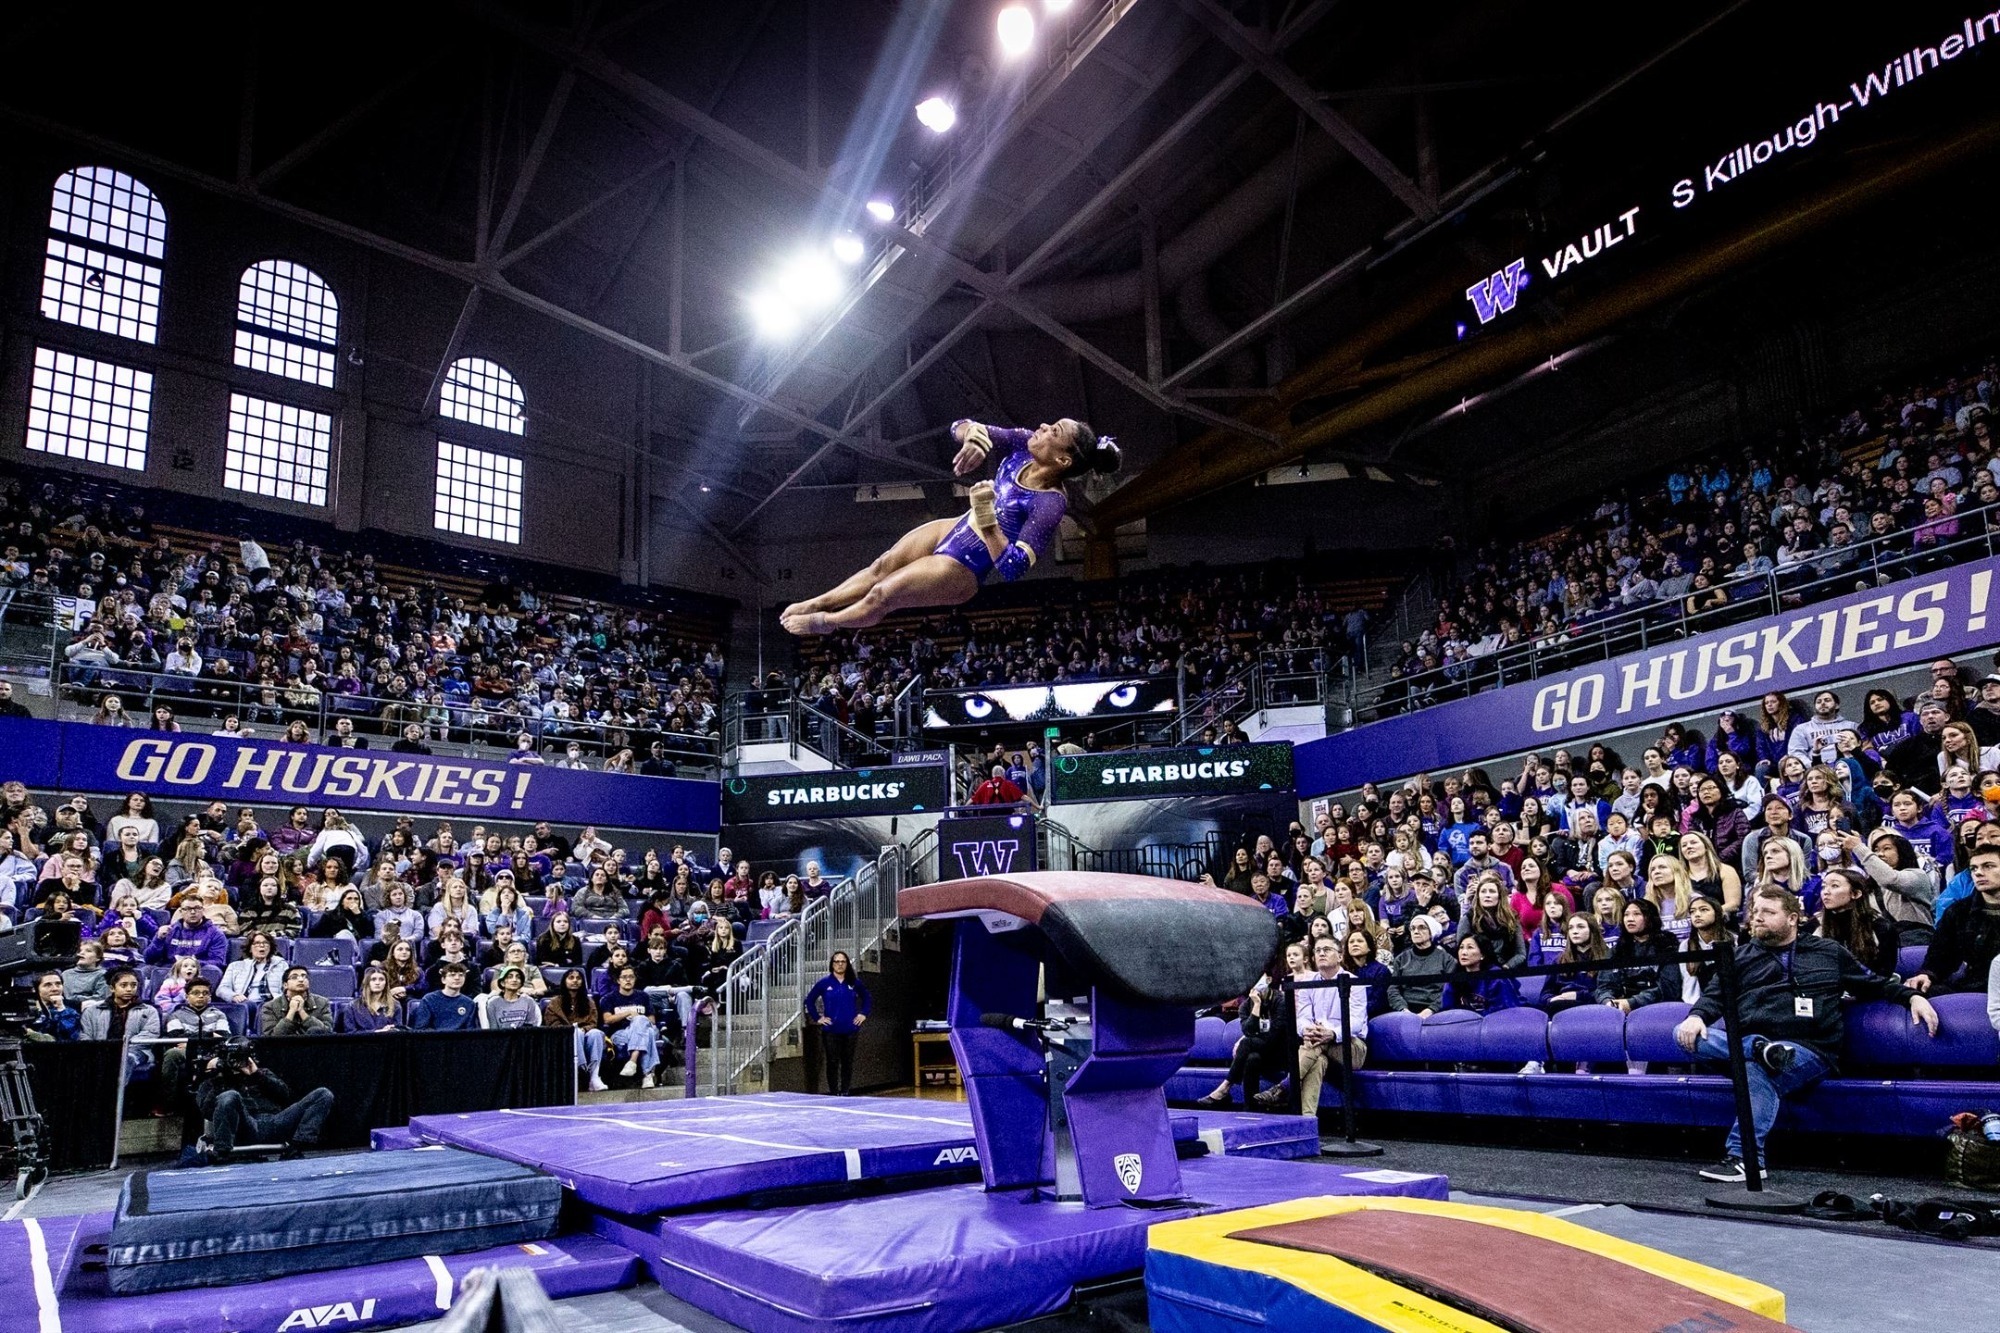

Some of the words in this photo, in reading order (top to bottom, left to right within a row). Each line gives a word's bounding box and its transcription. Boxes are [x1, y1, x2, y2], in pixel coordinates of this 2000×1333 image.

[1542, 206, 1640, 279] VAULT
[1672, 179, 1694, 209] S
[1531, 673, 1605, 732] GO
[115, 738, 218, 785] GO
[897, 754, 920, 763] DAWG
[922, 753, 943, 762] PACK
[1101, 760, 1246, 785] STARBUCKS
[767, 782, 902, 806] STARBUCKS
[953, 840, 1019, 879] W
